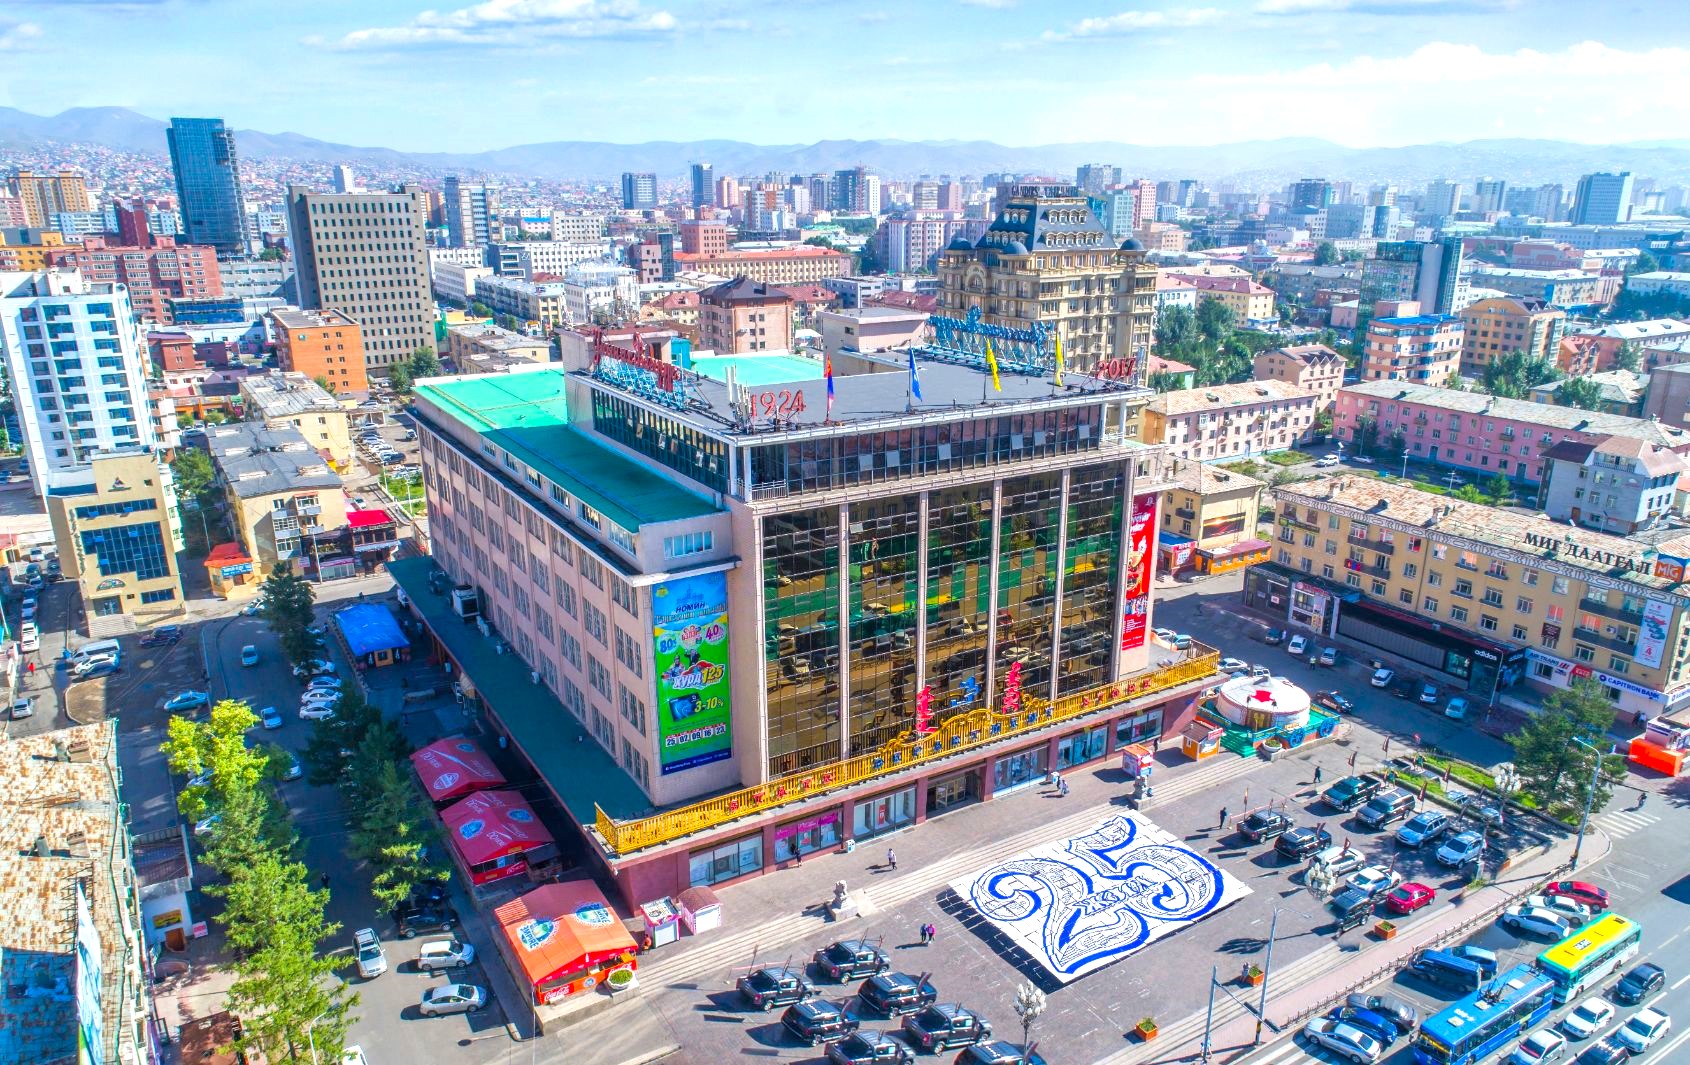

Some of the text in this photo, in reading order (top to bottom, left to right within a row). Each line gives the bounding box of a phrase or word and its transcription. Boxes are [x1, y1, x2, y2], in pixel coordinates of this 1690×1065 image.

[1096, 357, 1136, 379] 2017
[751, 389, 806, 416] 1924
[1523, 532, 1652, 575] МИГ ДААТГАЛ
[1657, 562, 1680, 579] MIG
[676, 602, 706, 614] НОМИН
[1474, 649, 1498, 661] adidas
[701, 665, 724, 684] 125
[1607, 677, 1641, 694] CAPITRON
[1641, 688, 1660, 699] BANK
[694, 697, 724, 713] 3-10%
[667, 738, 676, 747] 25
[680, 735, 689, 743] 02
[692, 731, 701, 740] 09
[704, 728, 712, 737] 16
[970, 815, 1224, 975] 25
